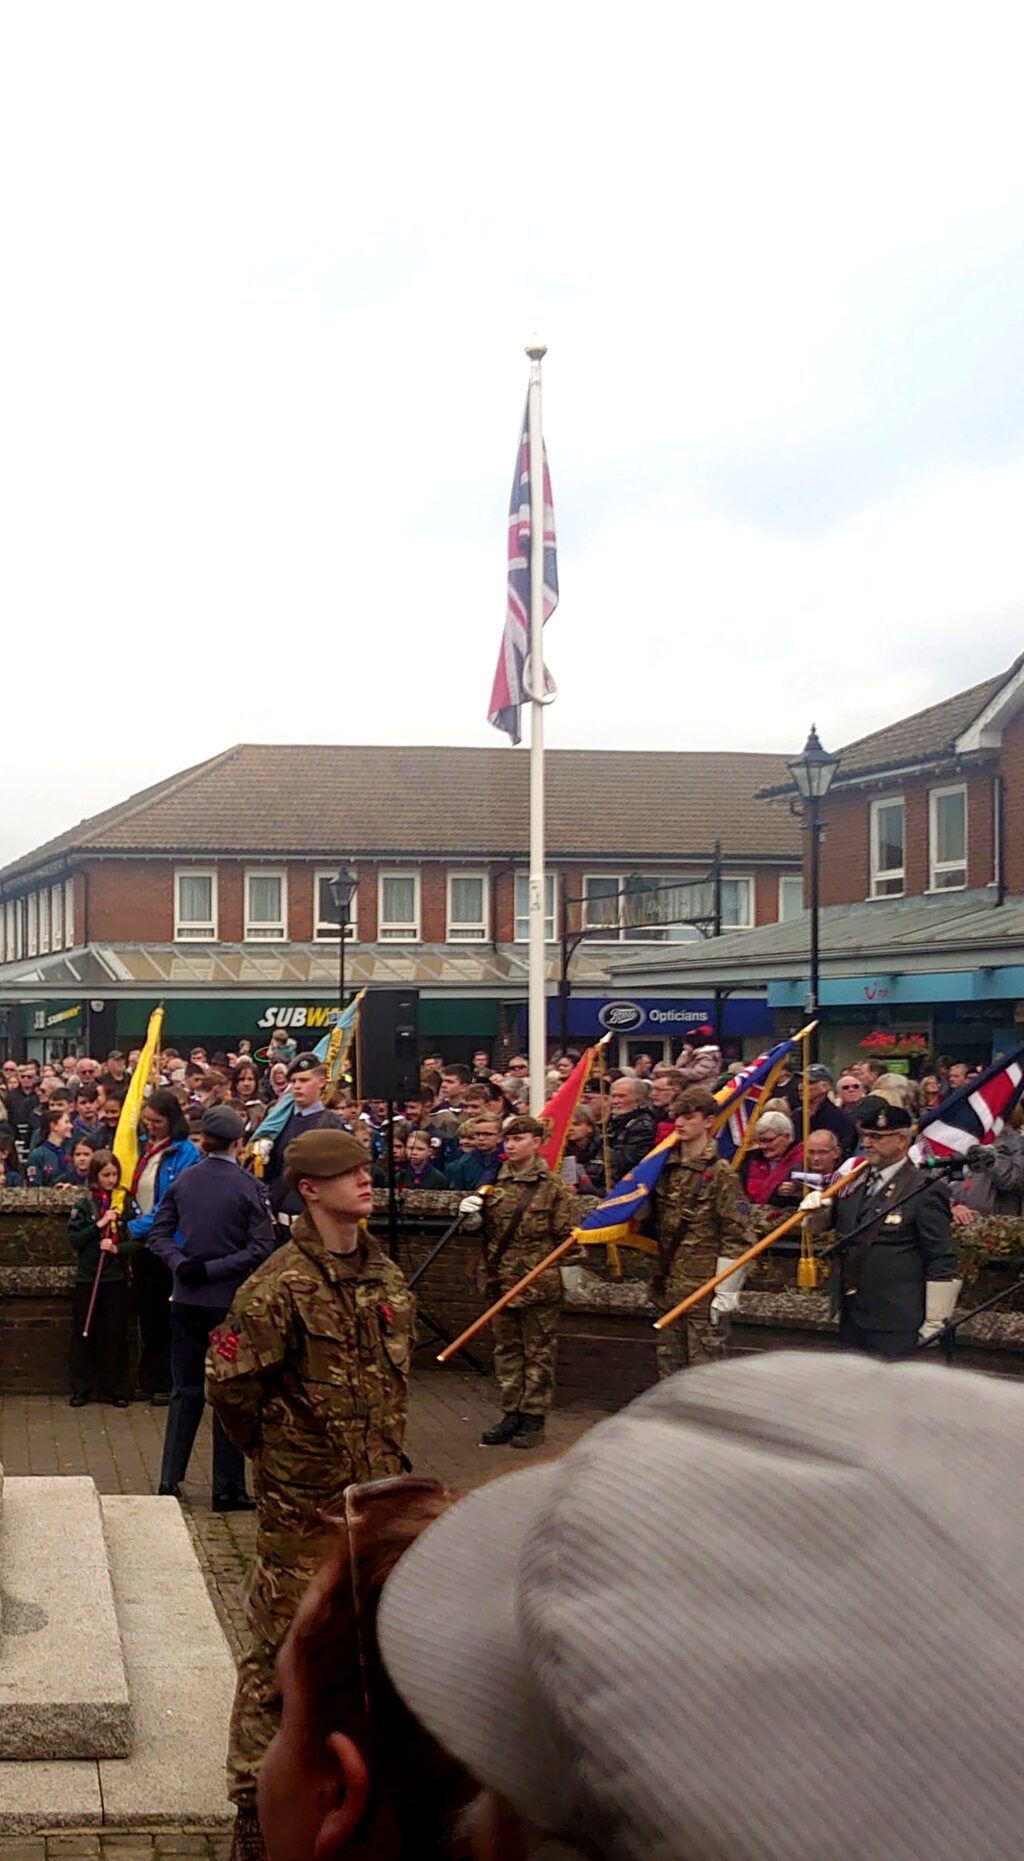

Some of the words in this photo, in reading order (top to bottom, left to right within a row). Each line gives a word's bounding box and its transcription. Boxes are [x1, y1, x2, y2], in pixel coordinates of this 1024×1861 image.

[257, 1006, 340, 1028] SUBW
[606, 1008, 638, 1024] Boots
[649, 1009, 708, 1023] Opticians
